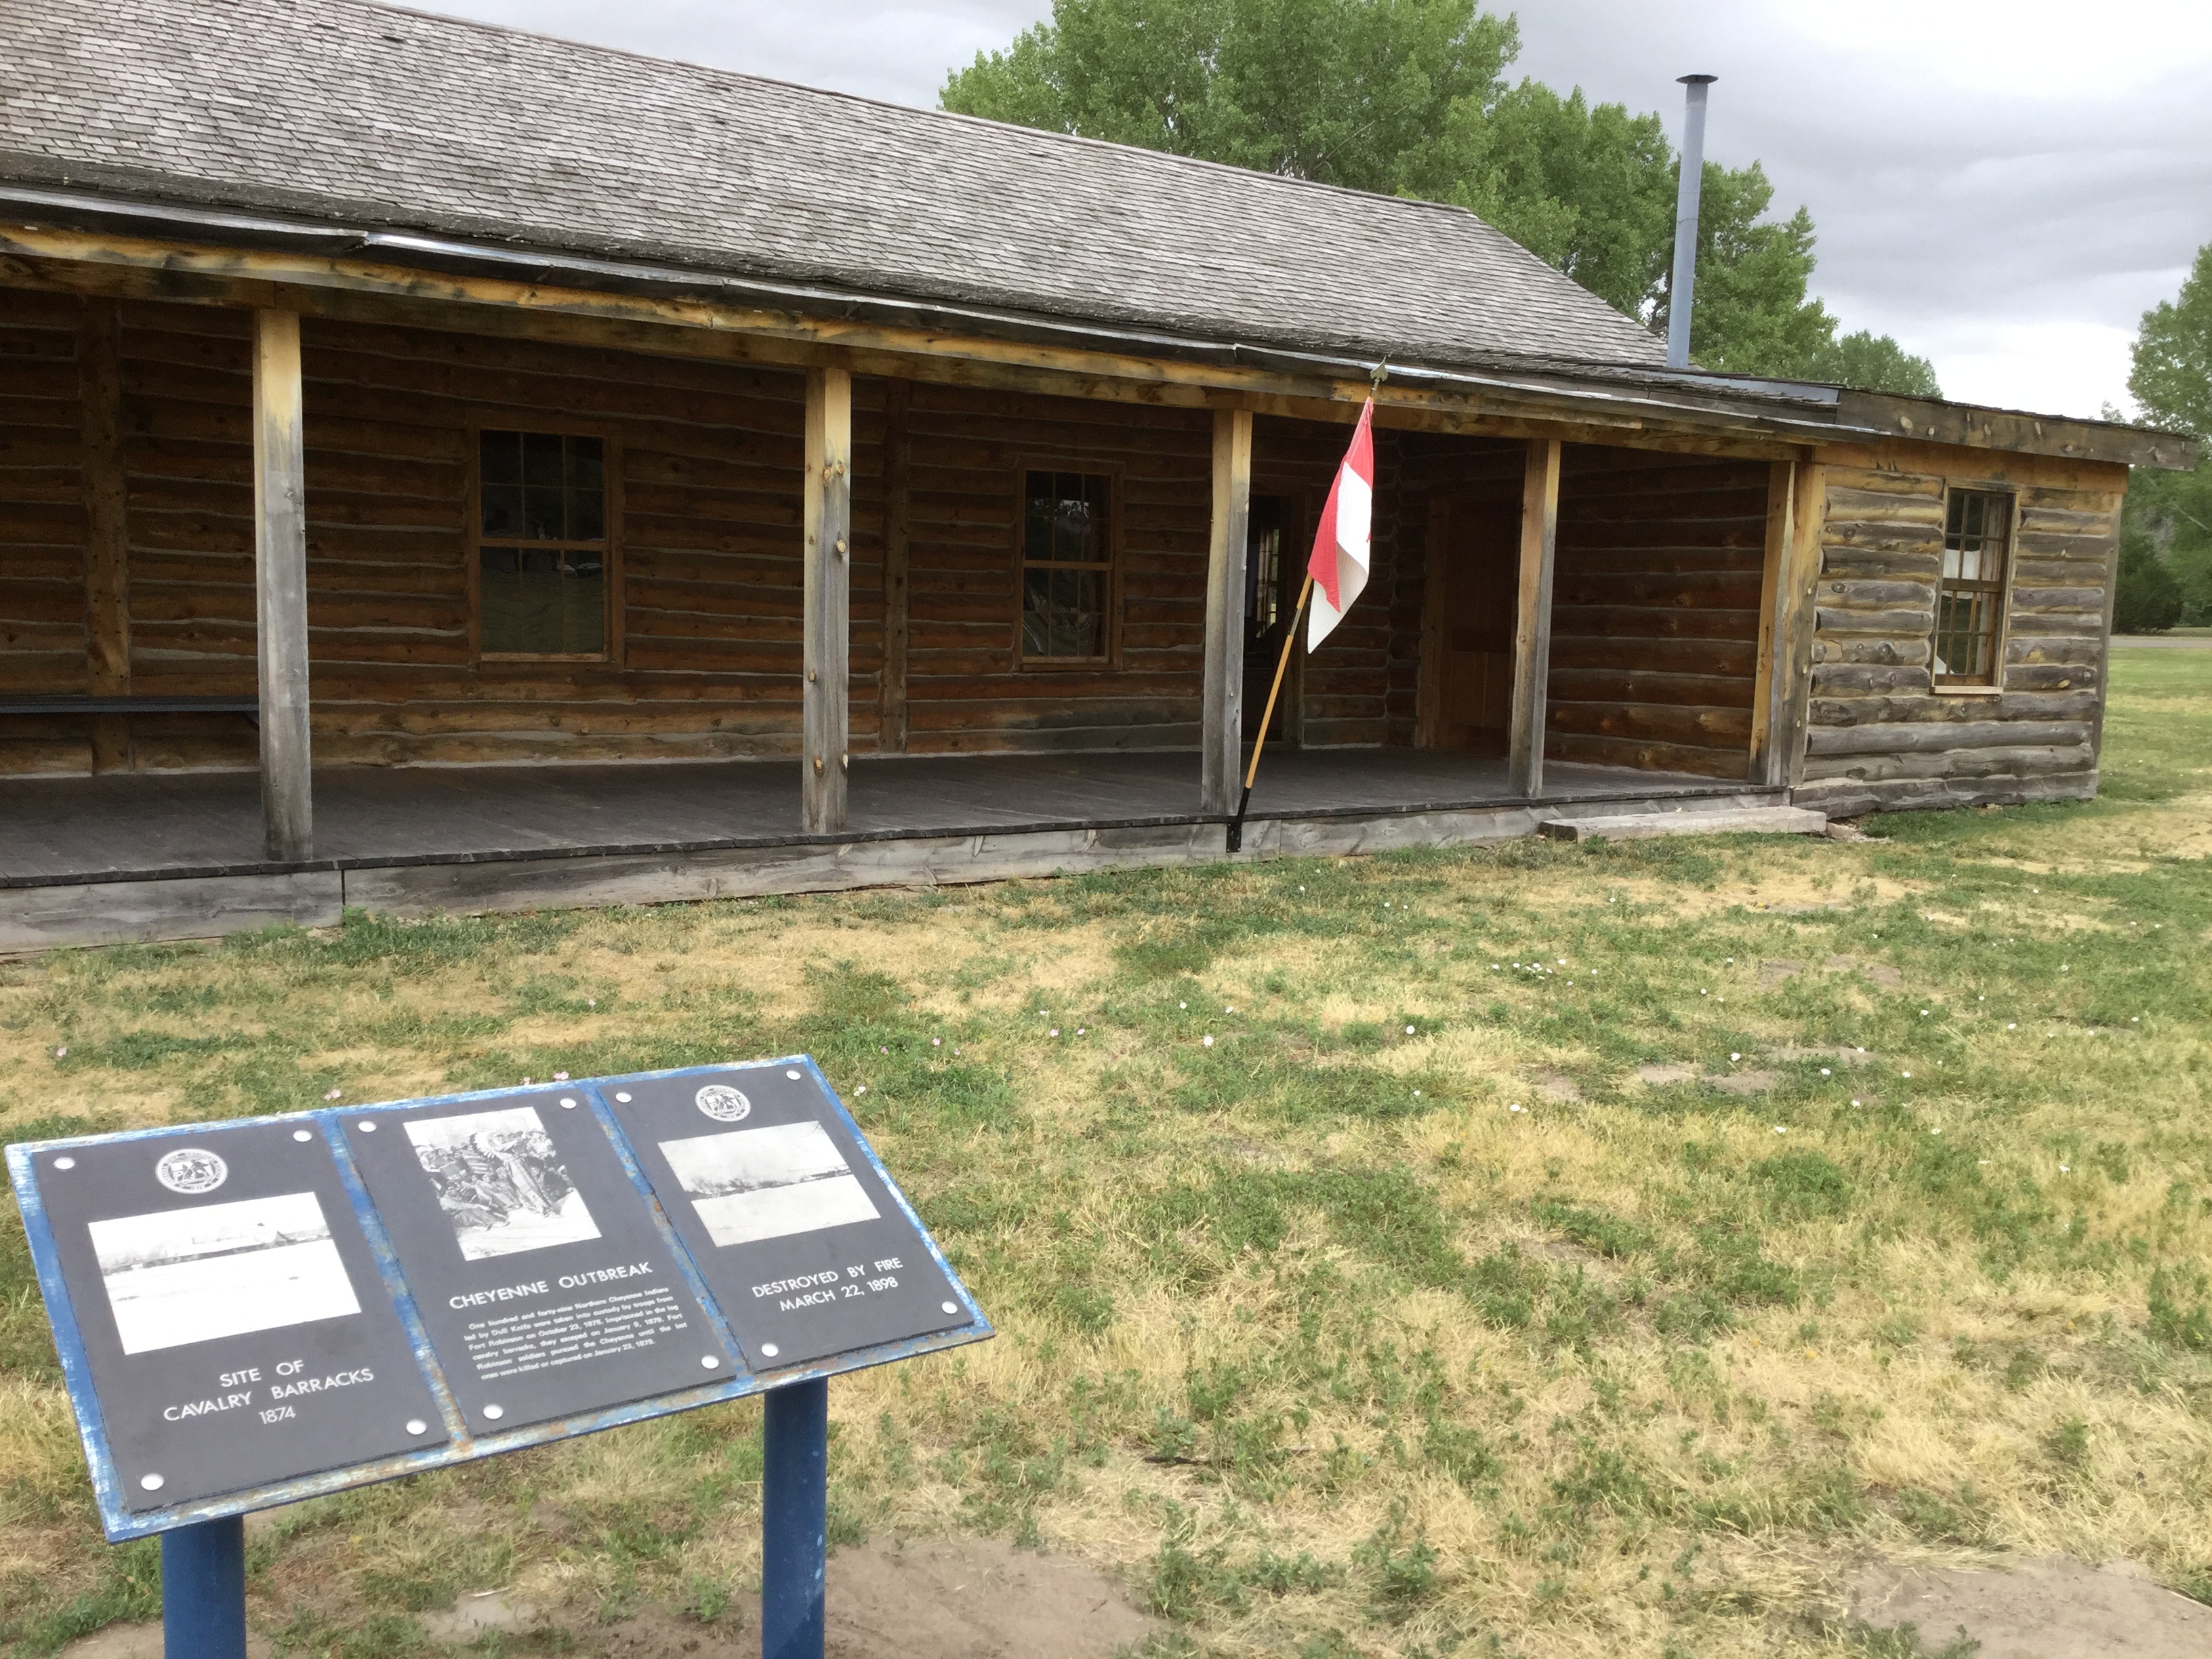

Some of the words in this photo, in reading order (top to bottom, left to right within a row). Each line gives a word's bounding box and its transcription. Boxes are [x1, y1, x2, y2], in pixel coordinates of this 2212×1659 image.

[449, 1281, 549, 1309] CHEYENNE
[558, 1262, 653, 1288] OUTBREAK
[752, 1271, 839, 1298] DESTROYED
[846, 1265, 866, 1277] BY
[874, 1257, 903, 1271] FIRE
[779, 1290, 836, 1311] MARCH
[840, 1284, 865, 1298] 22,
[867, 1276, 899, 1292] 1898
[487, 1315, 519, 1326] hundred
[521, 1312, 535, 1320] and
[219, 1368, 262, 1387] SITE
[276, 1359, 304, 1376] OF
[163, 1391, 252, 1420] CAVALRY
[270, 1368, 375, 1399] BARRACKS
[259, 1406, 296, 1425] 1874
